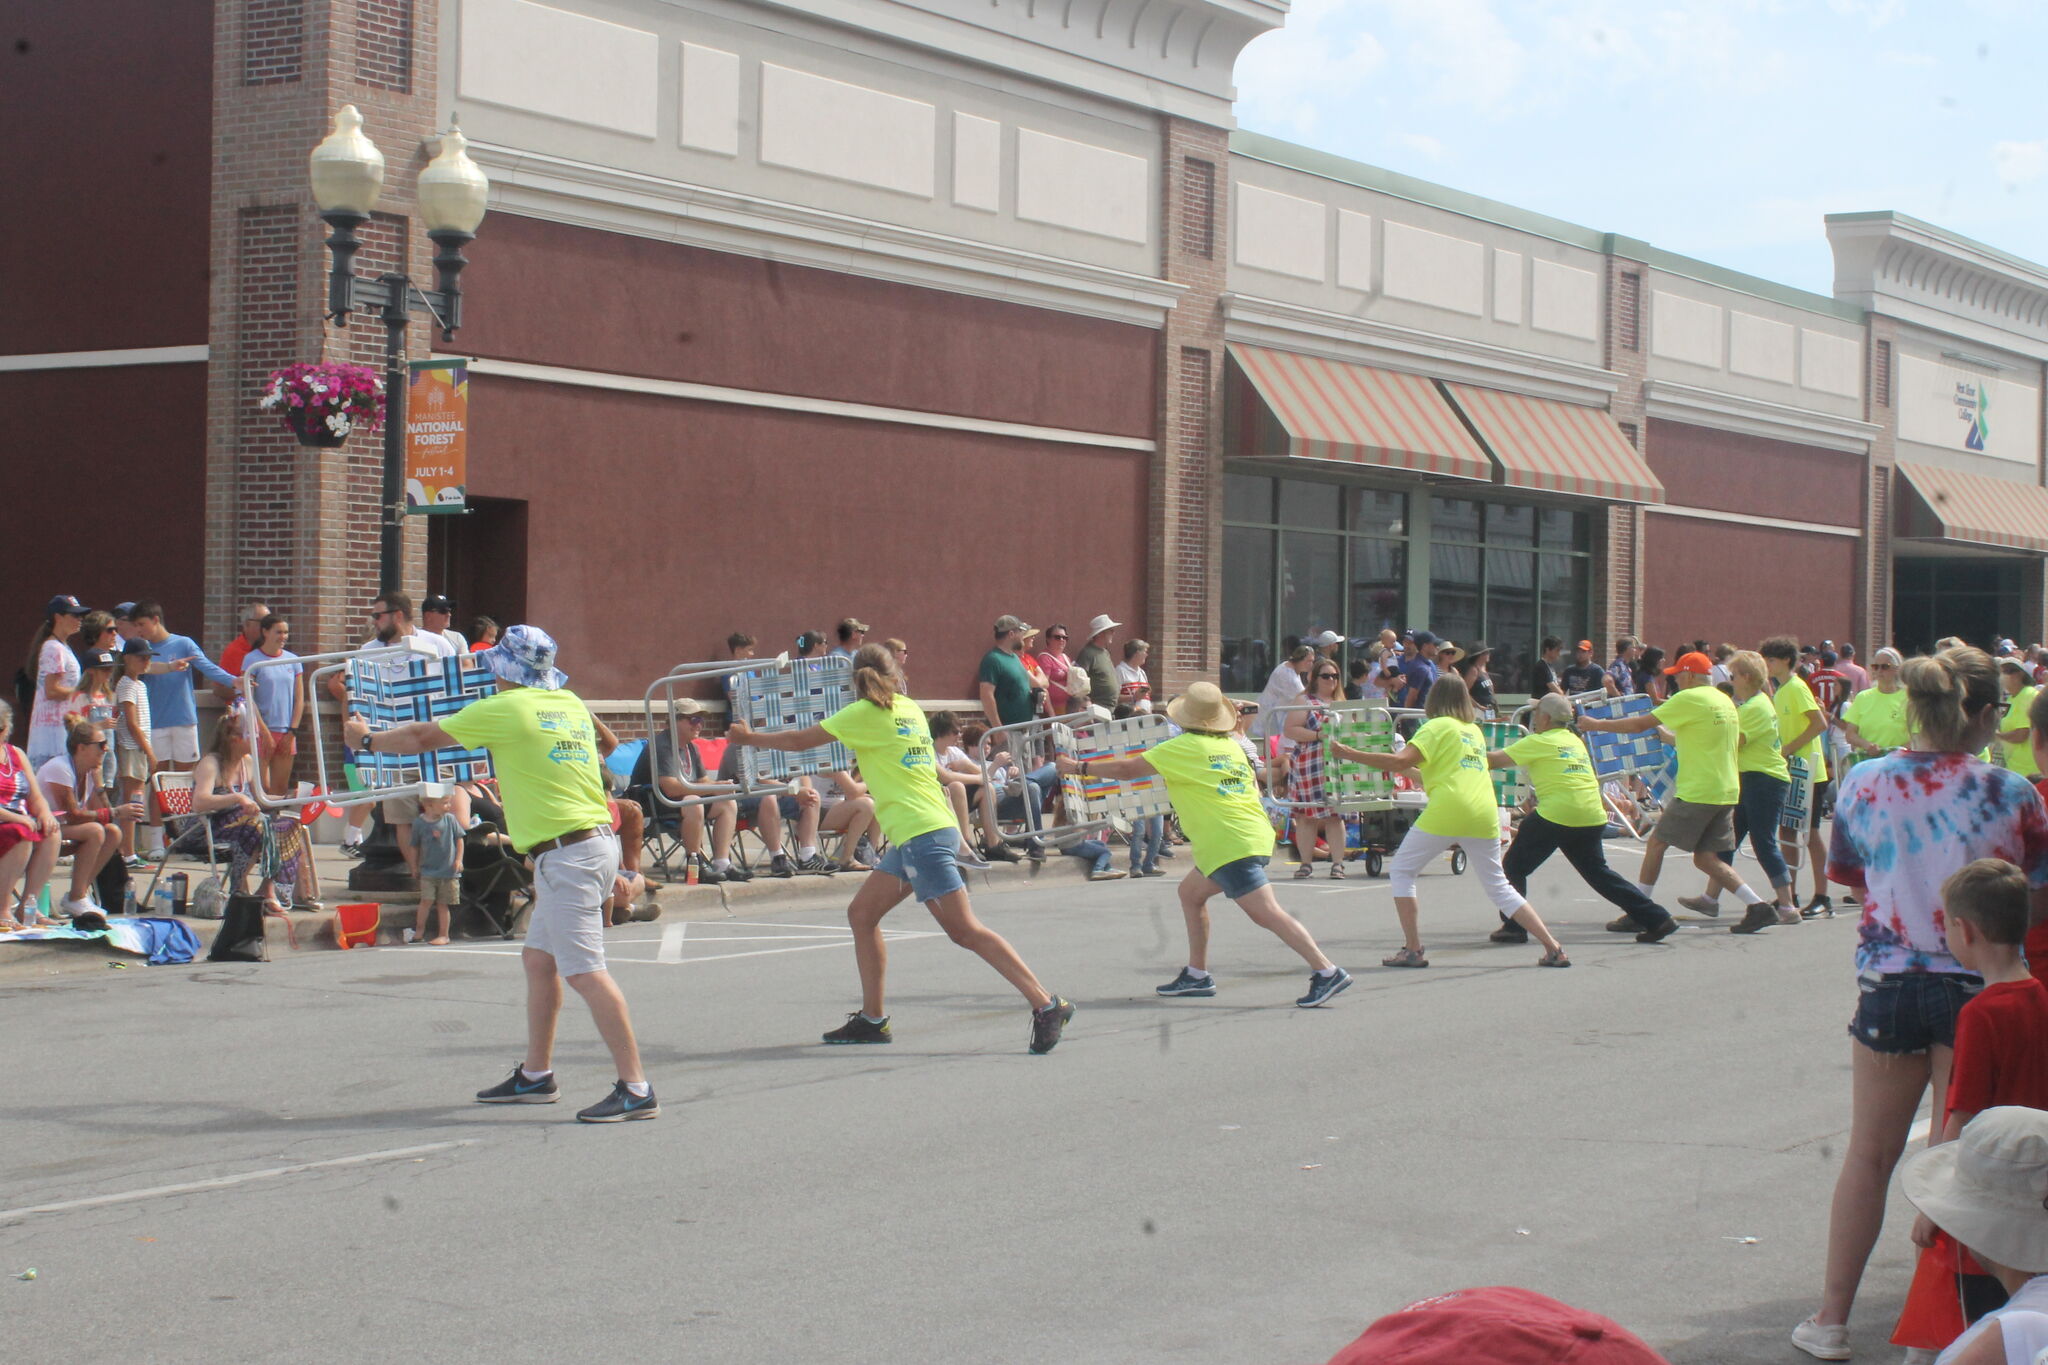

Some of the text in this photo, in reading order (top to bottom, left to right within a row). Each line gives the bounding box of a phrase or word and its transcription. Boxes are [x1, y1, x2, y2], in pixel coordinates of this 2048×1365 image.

[415, 411, 456, 421] MANISTEE
[408, 421, 464, 434] NATIONAL
[415, 433, 456, 446] FOREST
[415, 466, 454, 477] JULY 1-4
[556, 740, 583, 751] SERVE
[907, 746, 928, 756] SERVE
[1220, 777, 1240, 786] SERVE
